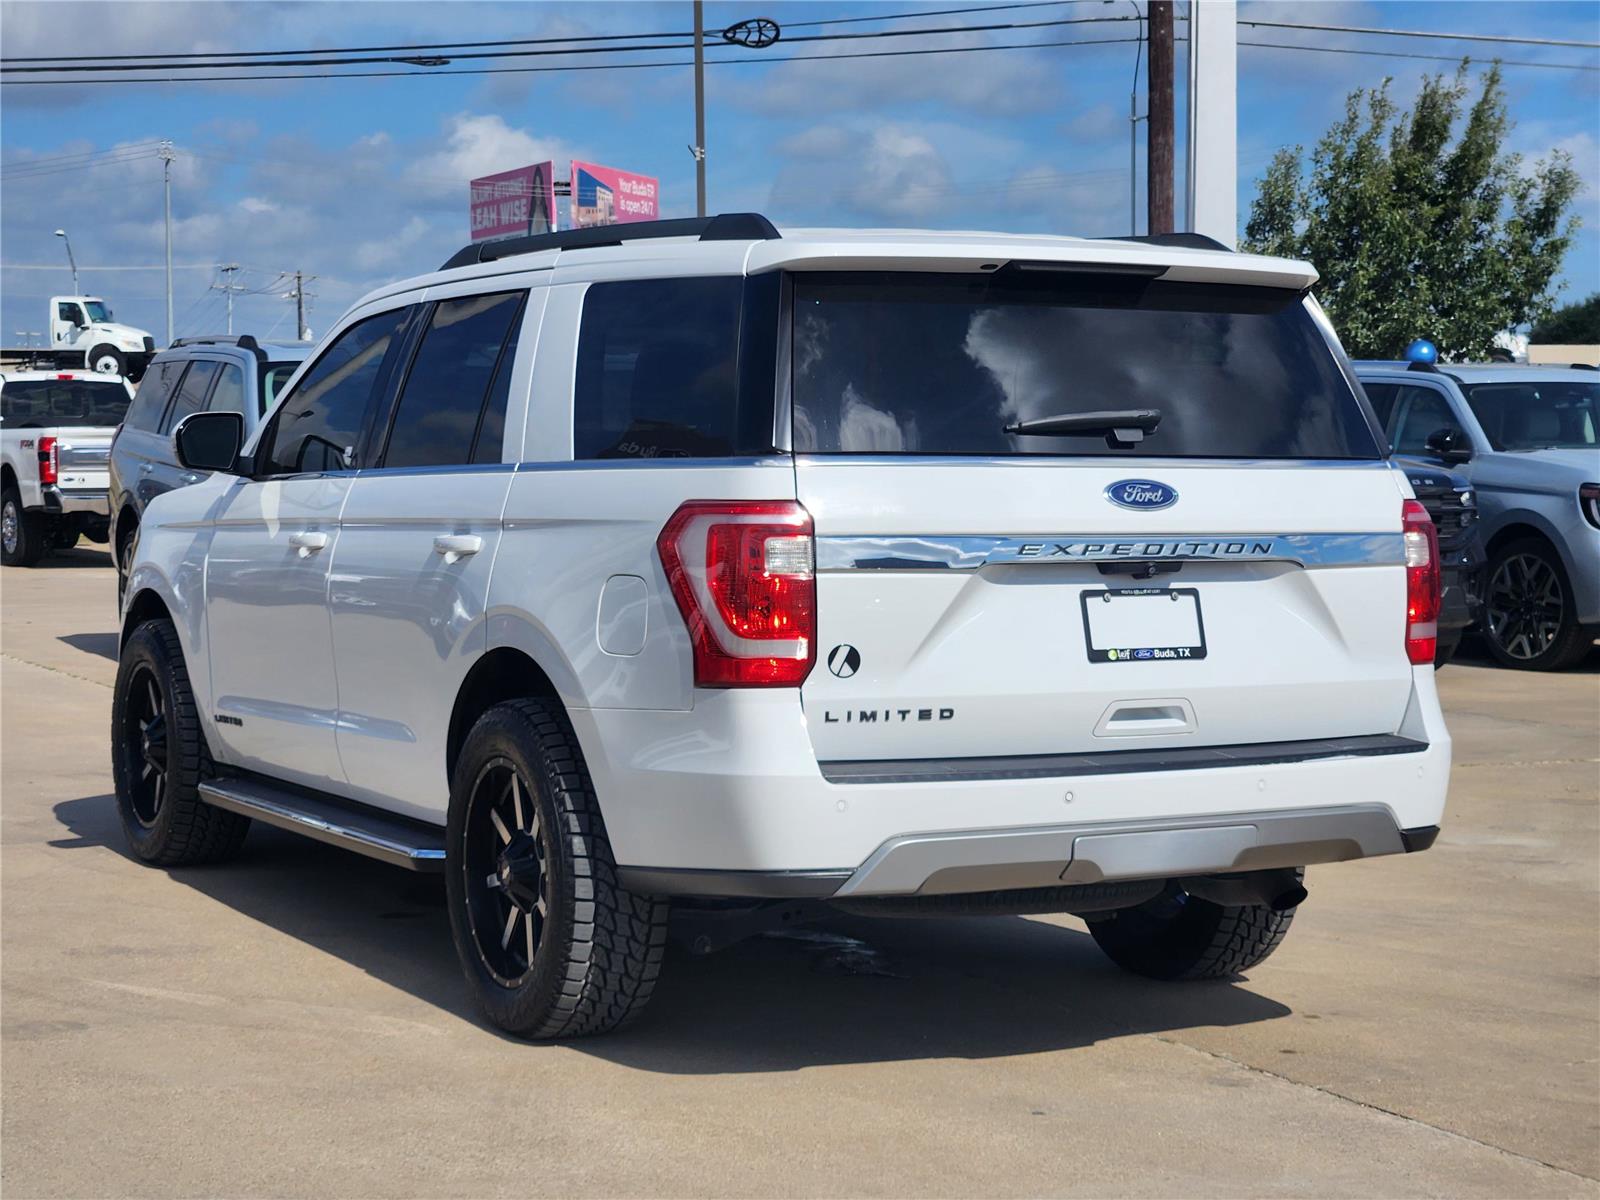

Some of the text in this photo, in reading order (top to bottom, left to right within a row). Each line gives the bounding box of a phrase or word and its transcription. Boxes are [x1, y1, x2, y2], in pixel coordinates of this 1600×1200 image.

[618, 177, 655, 198] Your Buda ER
[472, 198, 528, 231] LEAH WISE
[619, 195, 626, 210] is
[625, 199, 641, 215] open
[1123, 483, 1163, 503] Ford
[1017, 542, 1274, 557] EXPEDITION
[1154, 649, 1177, 659] Buda,
[1177, 647, 1191, 657] TX
[824, 708, 955, 723] LIMITED
